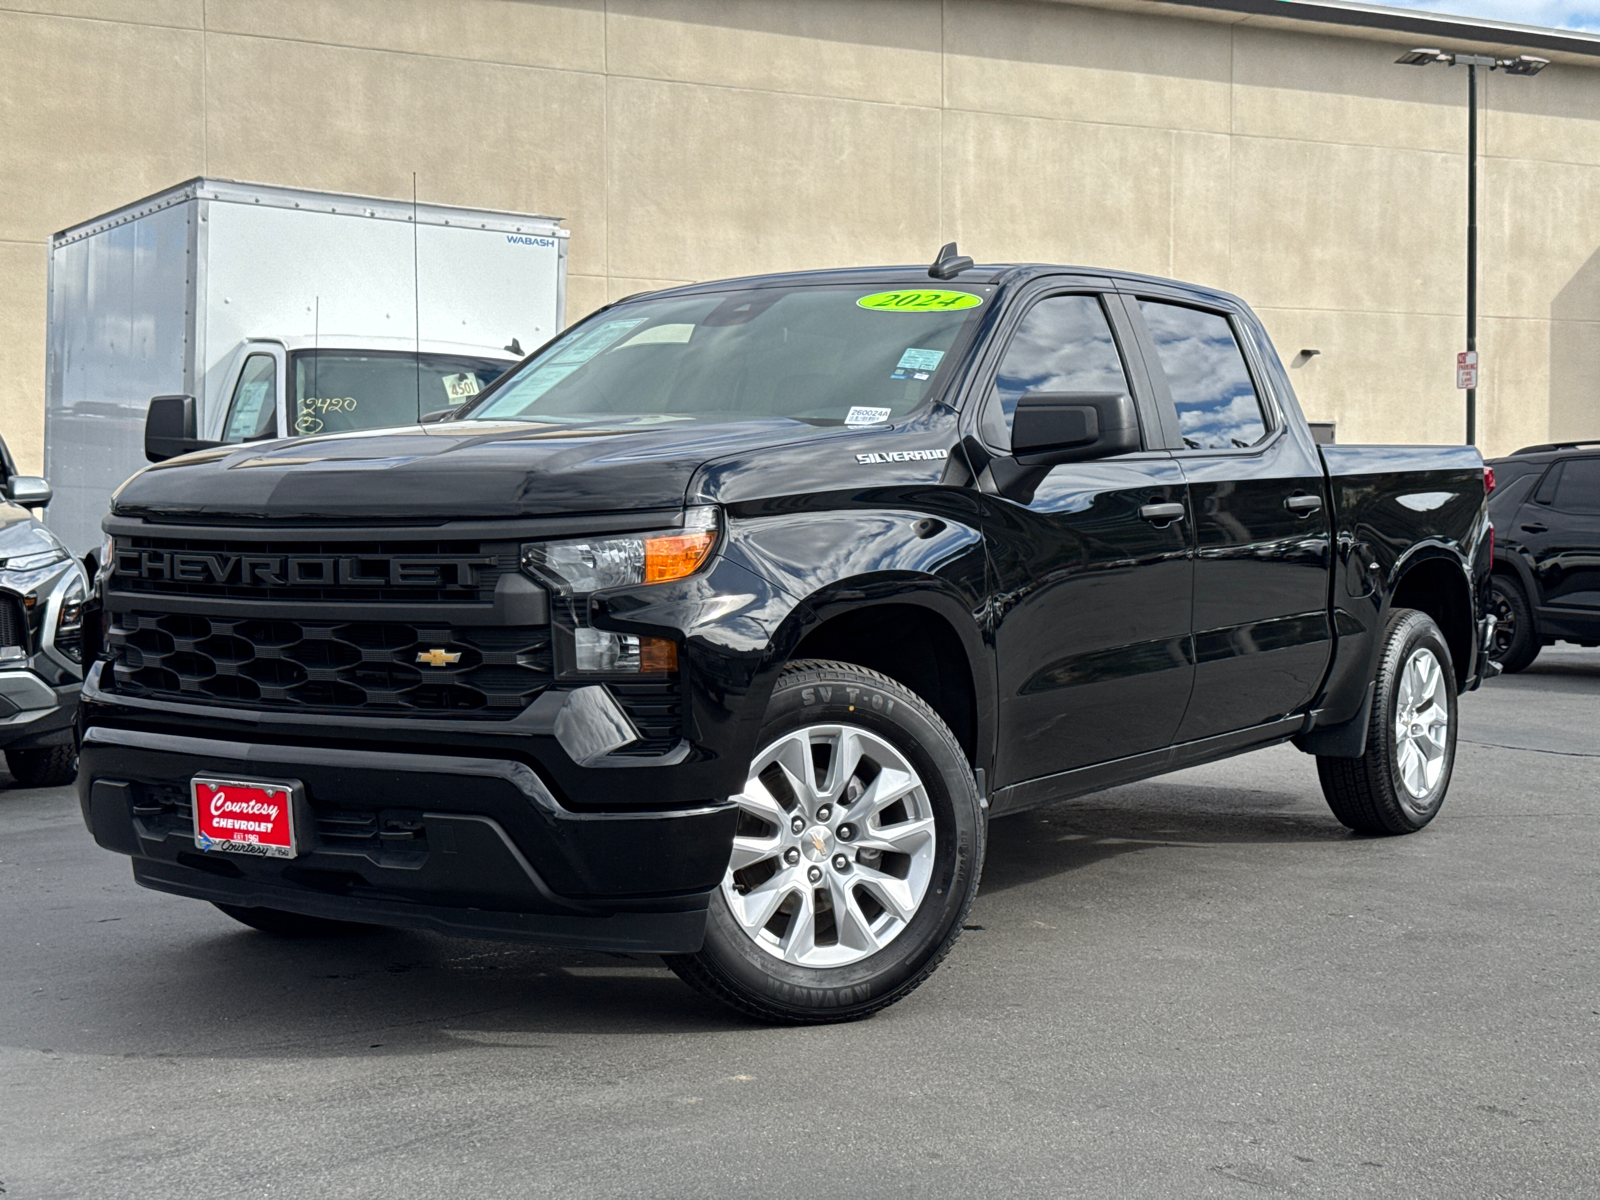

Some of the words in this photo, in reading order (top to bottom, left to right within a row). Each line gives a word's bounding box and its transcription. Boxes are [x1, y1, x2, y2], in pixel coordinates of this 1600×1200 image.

[506, 235, 555, 248] WABASH
[872, 294, 966, 307] 2024
[451, 381, 476, 396] 4501
[851, 409, 889, 418] 260024A
[855, 449, 948, 465] SILVERADO
[114, 548, 499, 588] CHEVROLET
[801, 686, 833, 706] SV
[210, 792, 279, 821] Courtesy
[212, 818, 274, 833] CHEVROLET
[221, 839, 269, 857] Courtesy
